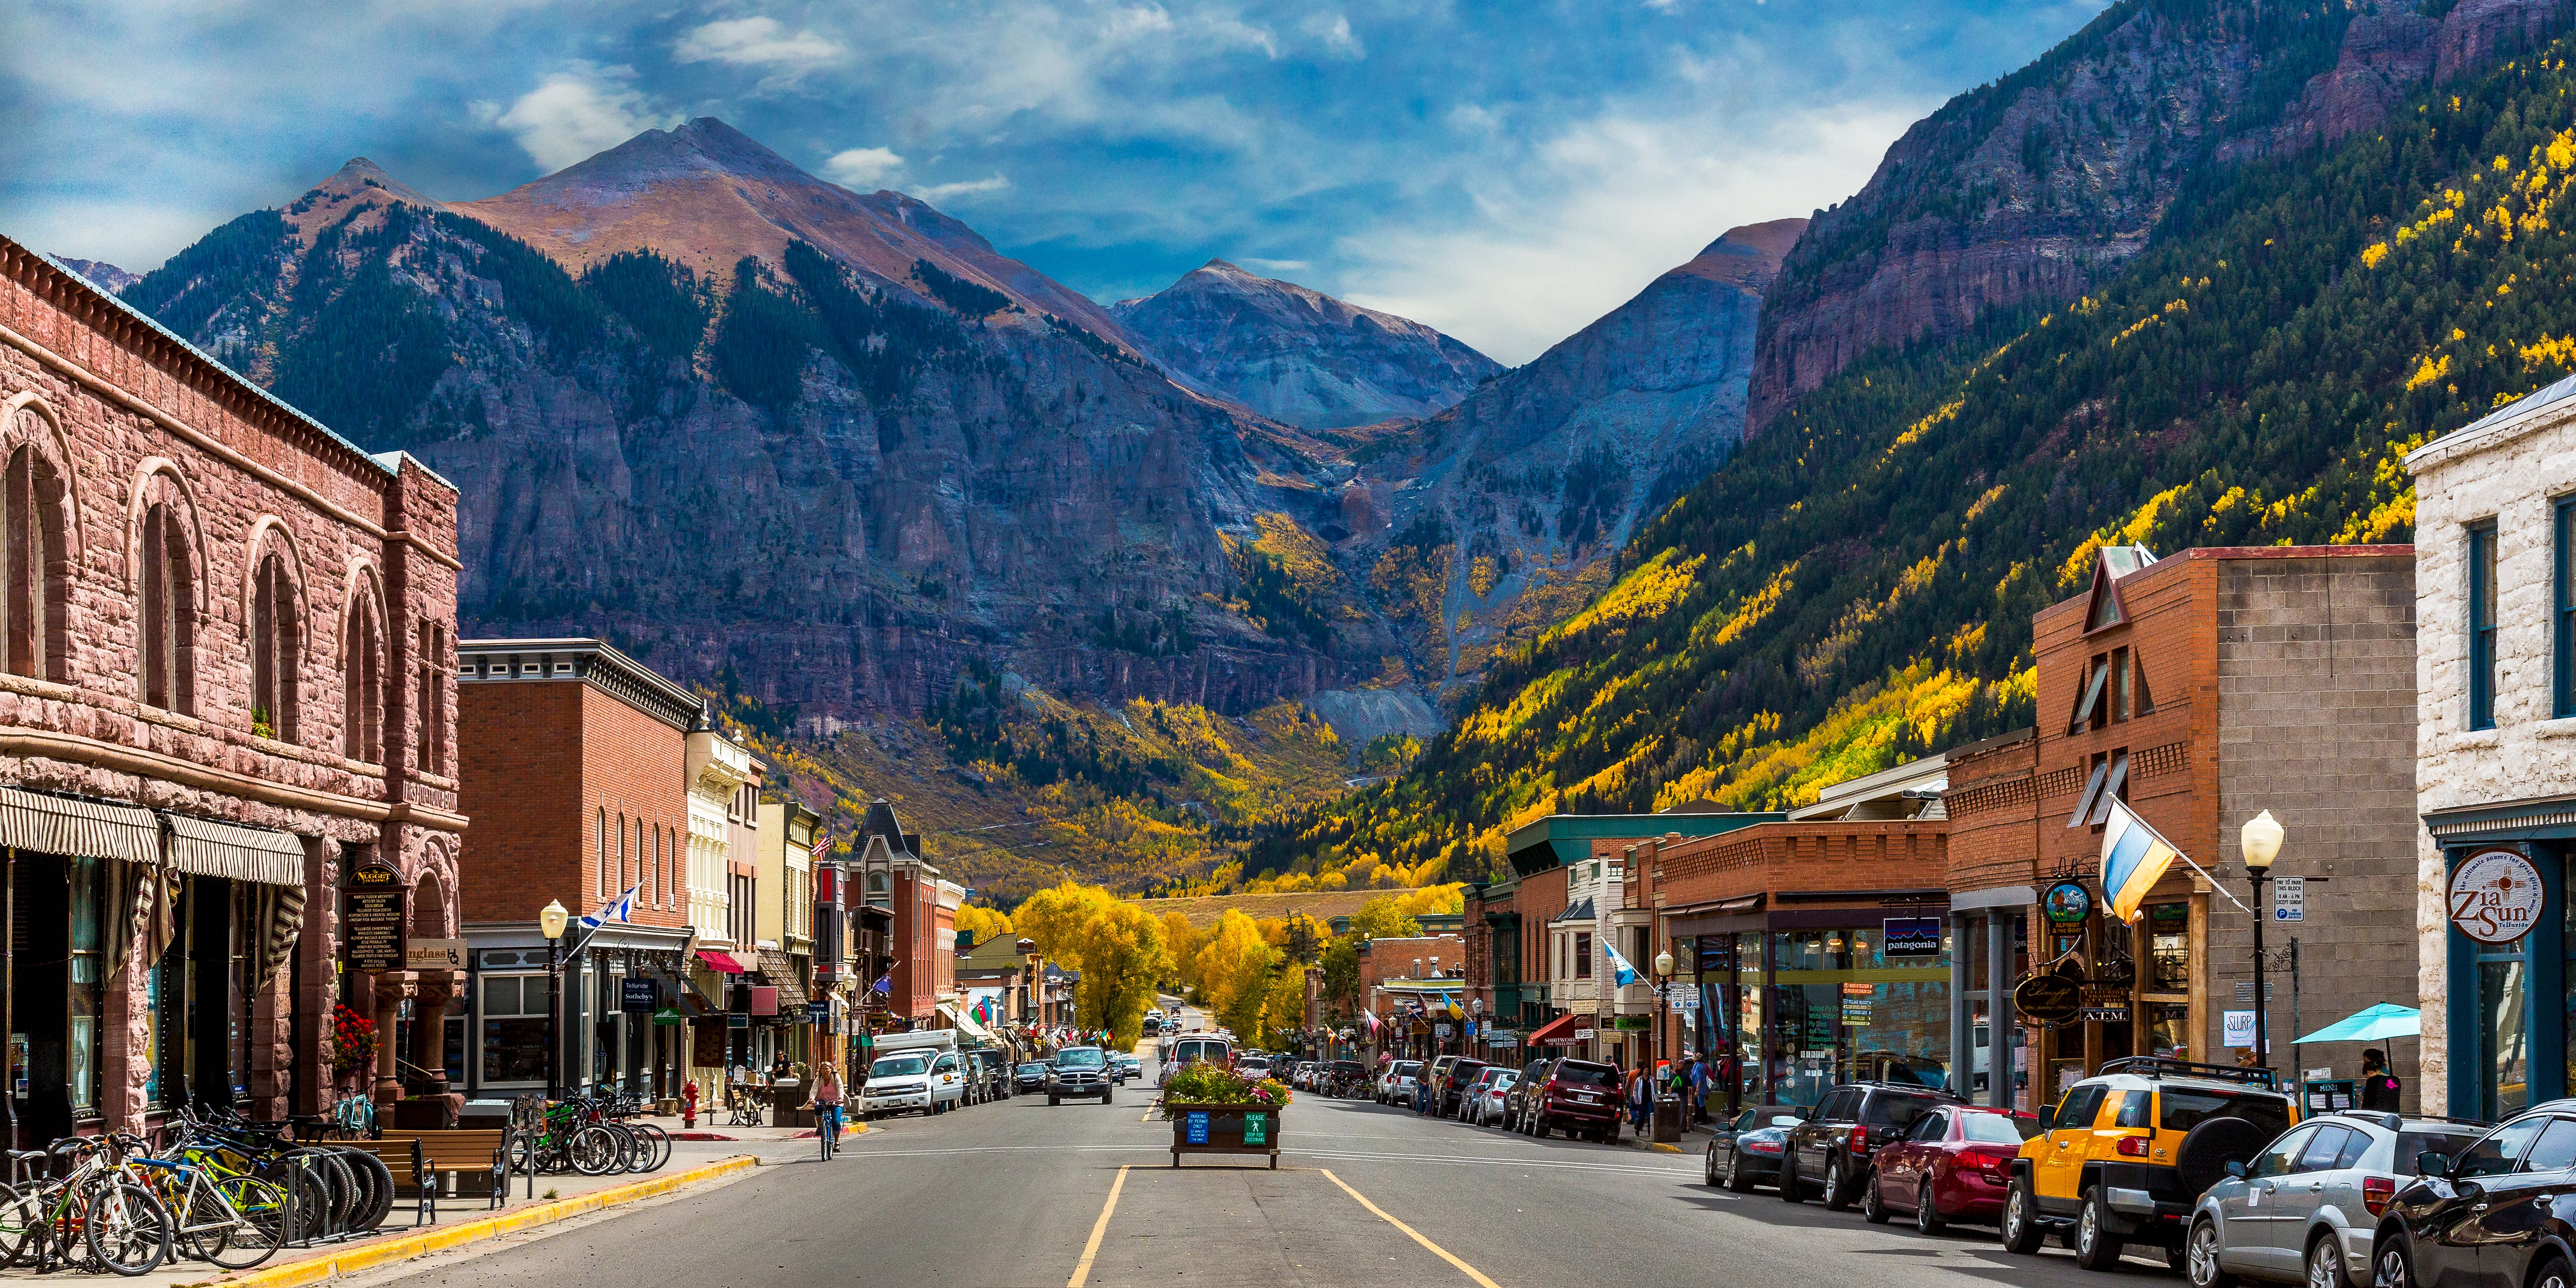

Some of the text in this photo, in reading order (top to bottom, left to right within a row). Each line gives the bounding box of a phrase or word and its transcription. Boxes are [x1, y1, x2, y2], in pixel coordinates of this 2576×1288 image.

[2465, 859, 2485, 879] ultimate
[2517, 862, 2534, 876] great
[358, 872, 390, 881] NUGGET
[2529, 876, 2538, 890] gifts
[2451, 885, 2501, 921] Zia
[2528, 899, 2536, 913] more
[2478, 906, 2528, 936] Sun
[1888, 941, 1936, 950] patagonia
[407, 947, 446, 961] nglass
[1619, 1019, 1648, 1027] sublime
[2227, 1015, 2251, 1030] SLURP
